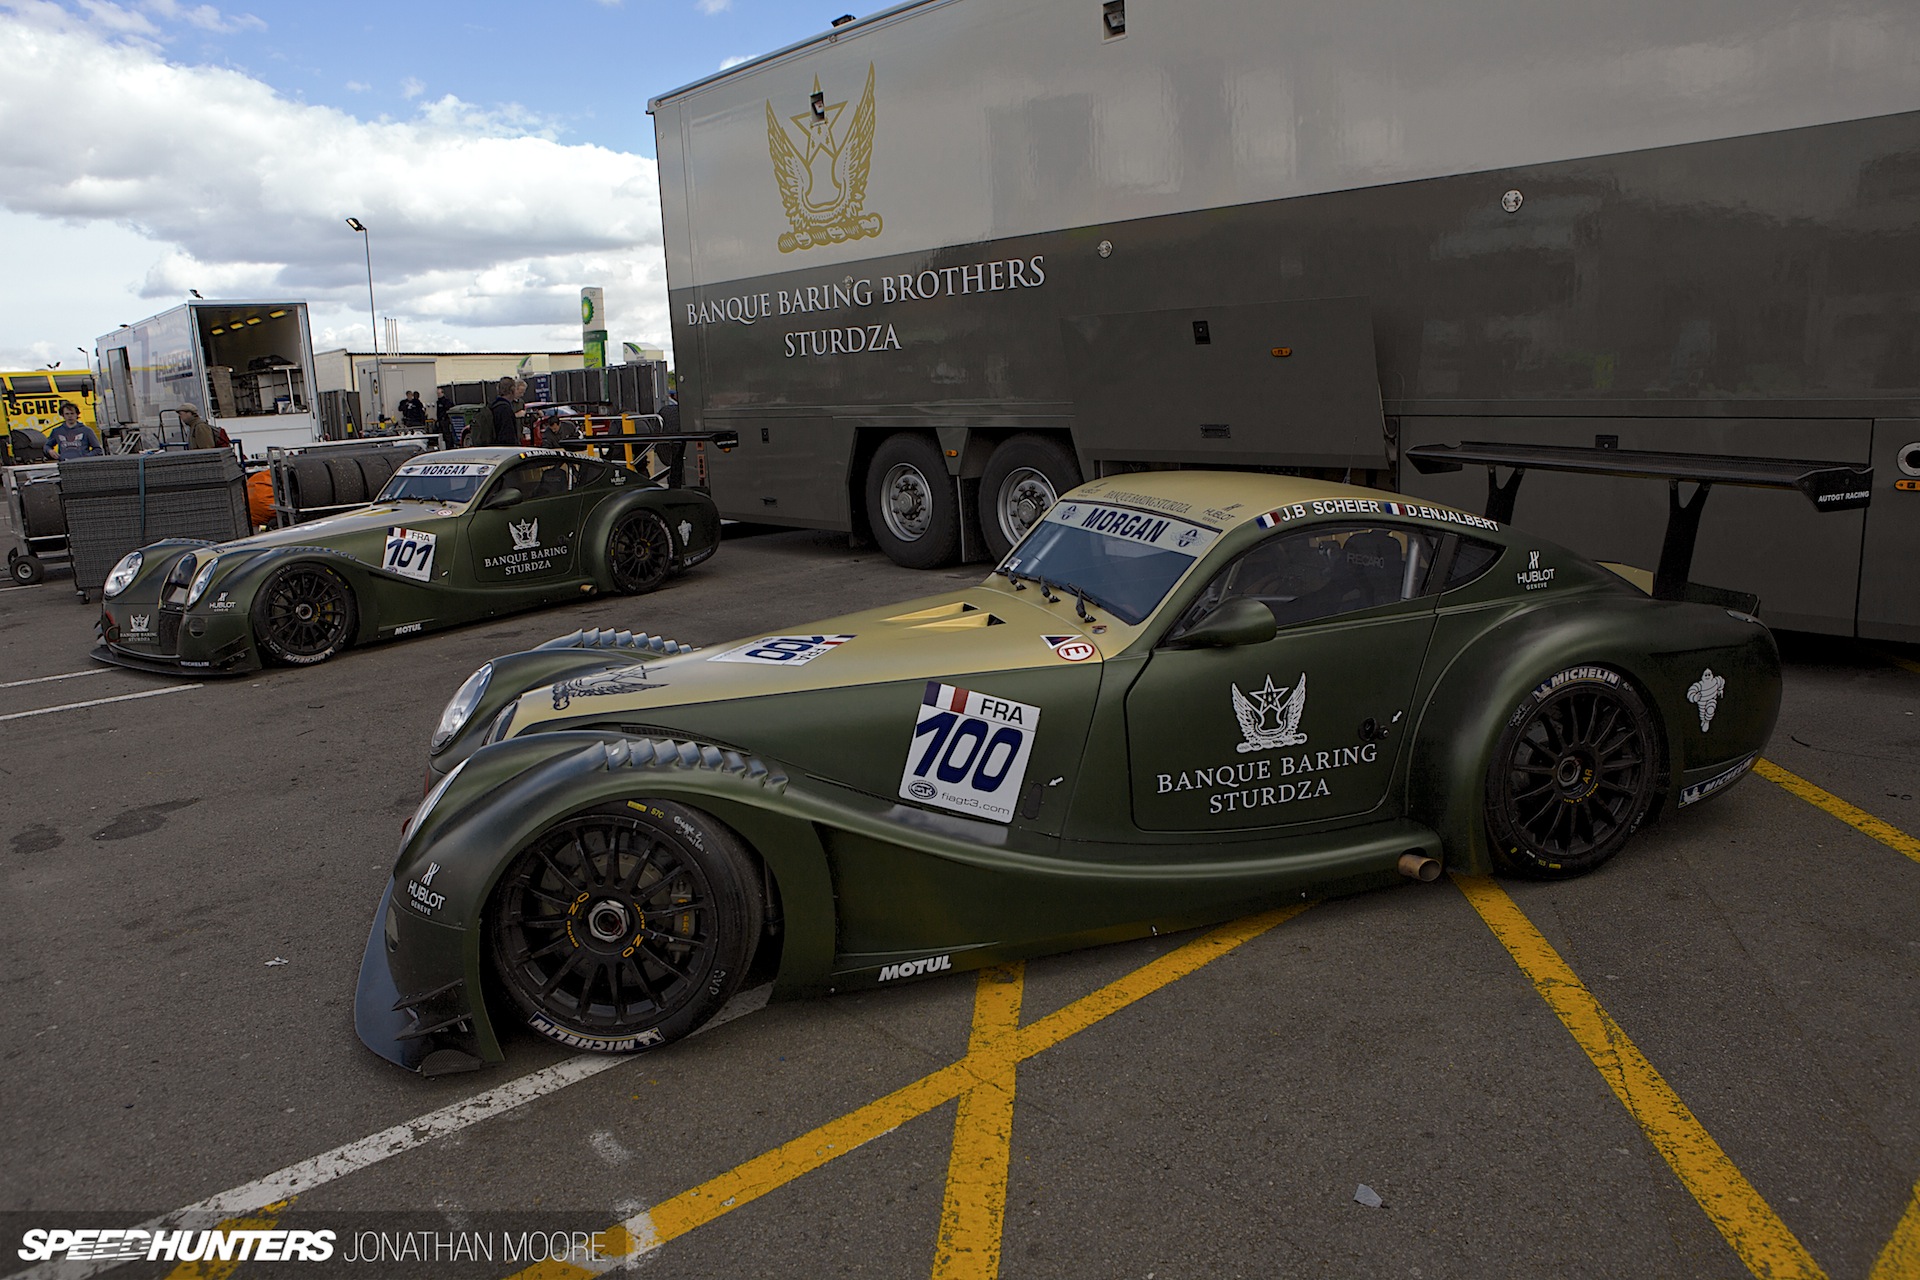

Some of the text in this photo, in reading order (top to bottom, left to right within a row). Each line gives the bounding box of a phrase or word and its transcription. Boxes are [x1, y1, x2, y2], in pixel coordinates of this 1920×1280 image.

[686, 254, 1047, 326] BANQUE BARING BROTHERS
[784, 322, 902, 358] STURDZA
[420, 465, 470, 475] MORGAN
[1818, 490, 1870, 503] AUTOGT RACING
[1202, 507, 1237, 522] HUBLOT
[1281, 500, 1381, 522] J.B SCHEIER
[1405, 504, 1500, 532] D.ENJALBERT
[411, 531, 431, 542] FRA
[1081, 507, 1171, 543] MORGAN
[387, 538, 434, 572] 101
[484, 545, 568, 568] BANQUE BARING
[1346, 552, 1385, 569] RECARO
[505, 560, 552, 576] STURDZA
[1516, 568, 1555, 584] HUBLOT
[209, 601, 237, 609] HUBLOT
[394, 623, 422, 635] MOTUL
[1551, 668, 1619, 688] MICHELIN
[980, 697, 1024, 725] FRA
[912, 711, 1024, 793] 100
[1156, 743, 1379, 795] BANQUE BARING
[941, 792, 1010, 816] fiagt3.com
[1209, 777, 1332, 815] STURDZA
[407, 879, 446, 910] HUBLOT
[410, 899, 432, 916] GENEVE
[878, 954, 952, 983] MOTUL
[531, 1018, 635, 1050] MICHELIN
